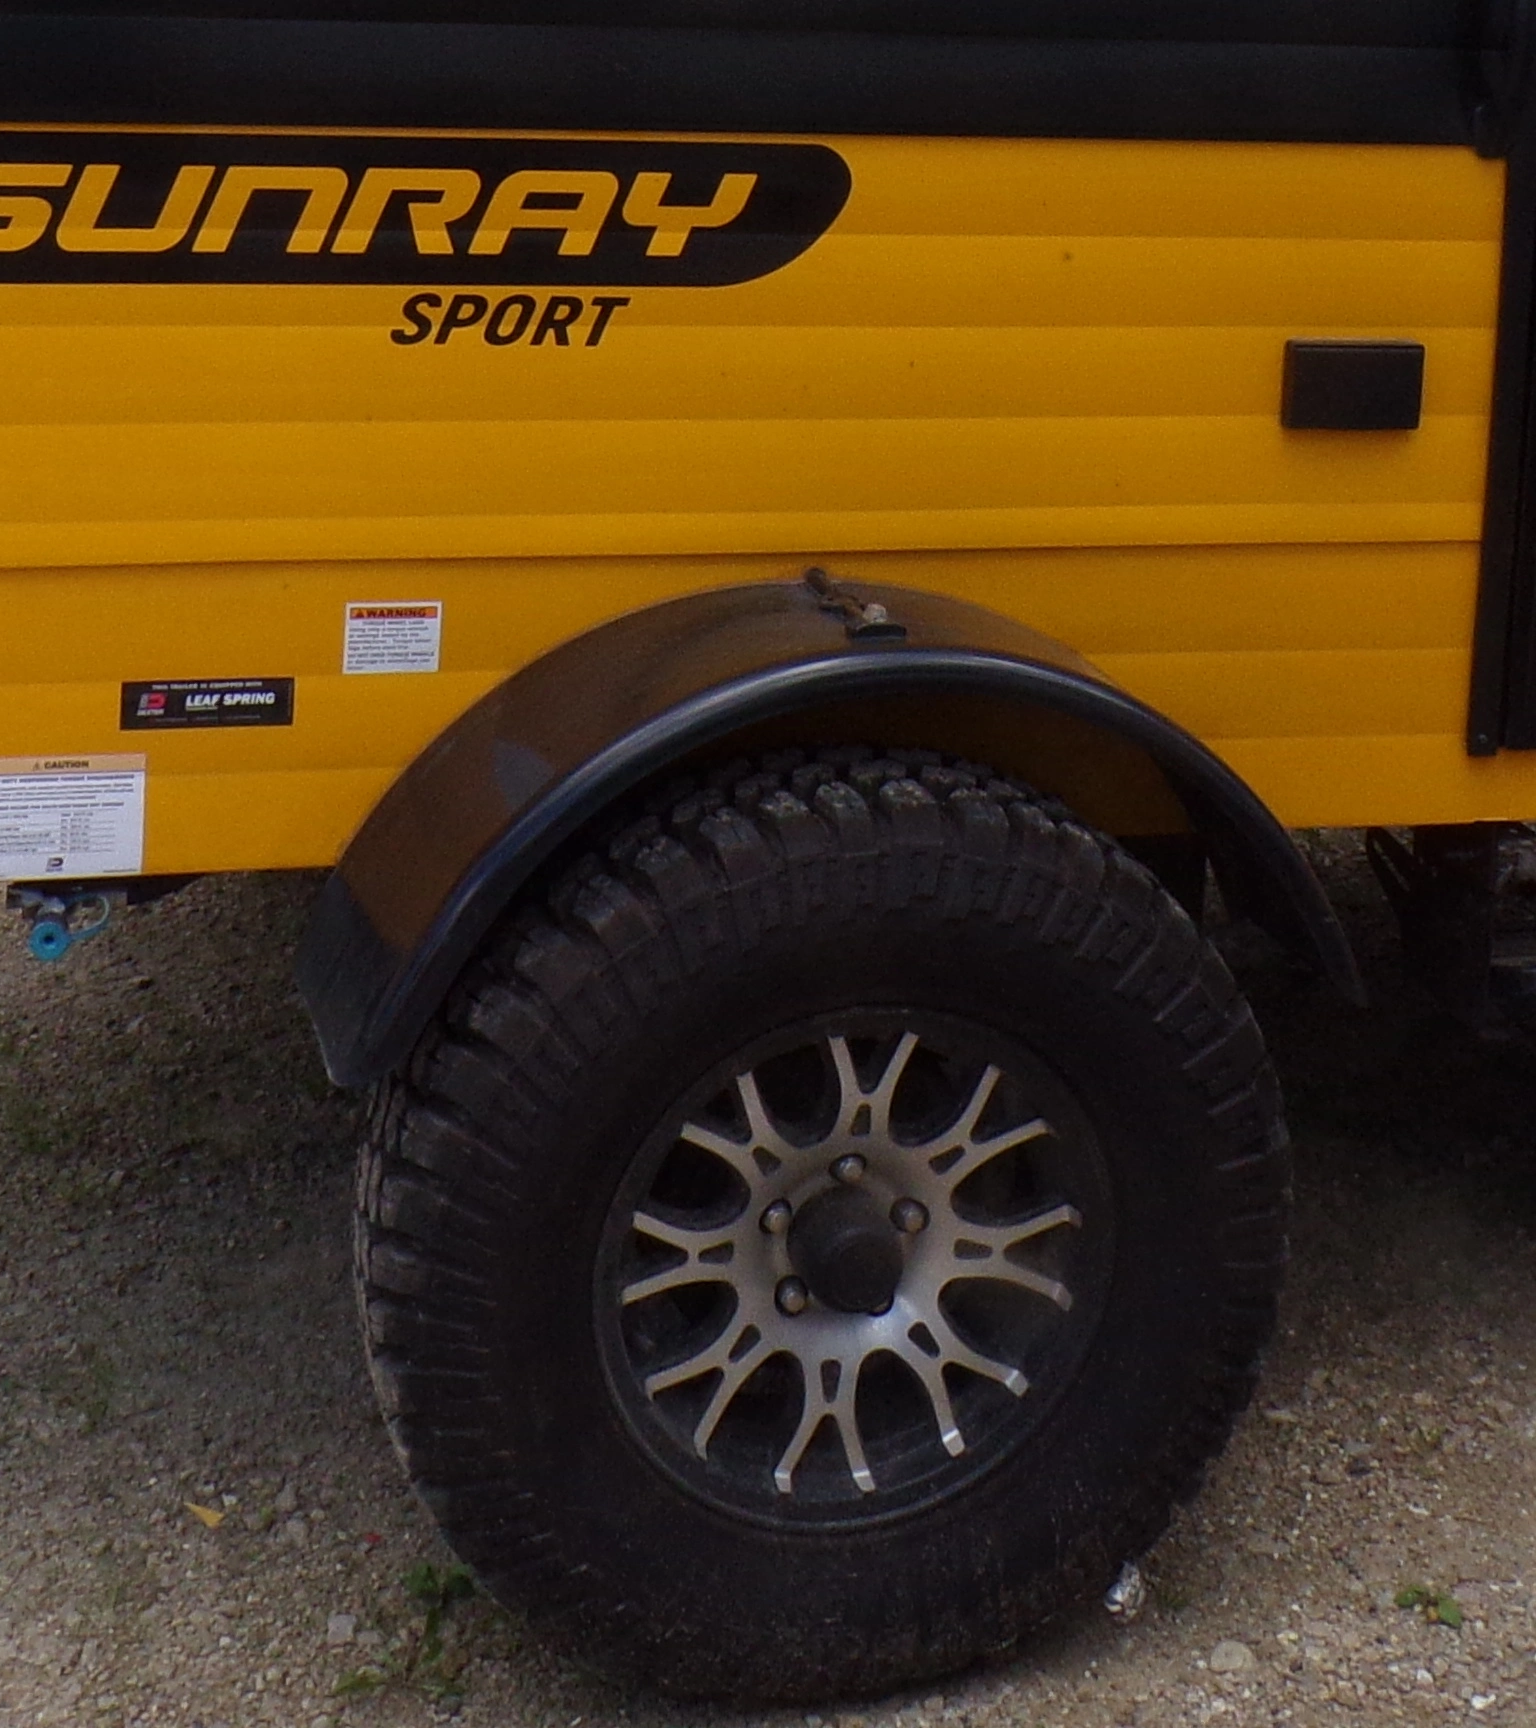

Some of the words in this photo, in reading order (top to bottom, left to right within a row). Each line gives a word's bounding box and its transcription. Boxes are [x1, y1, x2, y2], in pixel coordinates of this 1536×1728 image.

[389, 292, 630, 348] SPORT
[366, 607, 427, 619] WARNING
[185, 693, 222, 707] LEAF
[223, 692, 276, 706] SPRING
[44, 760, 90, 770] CAUTION
